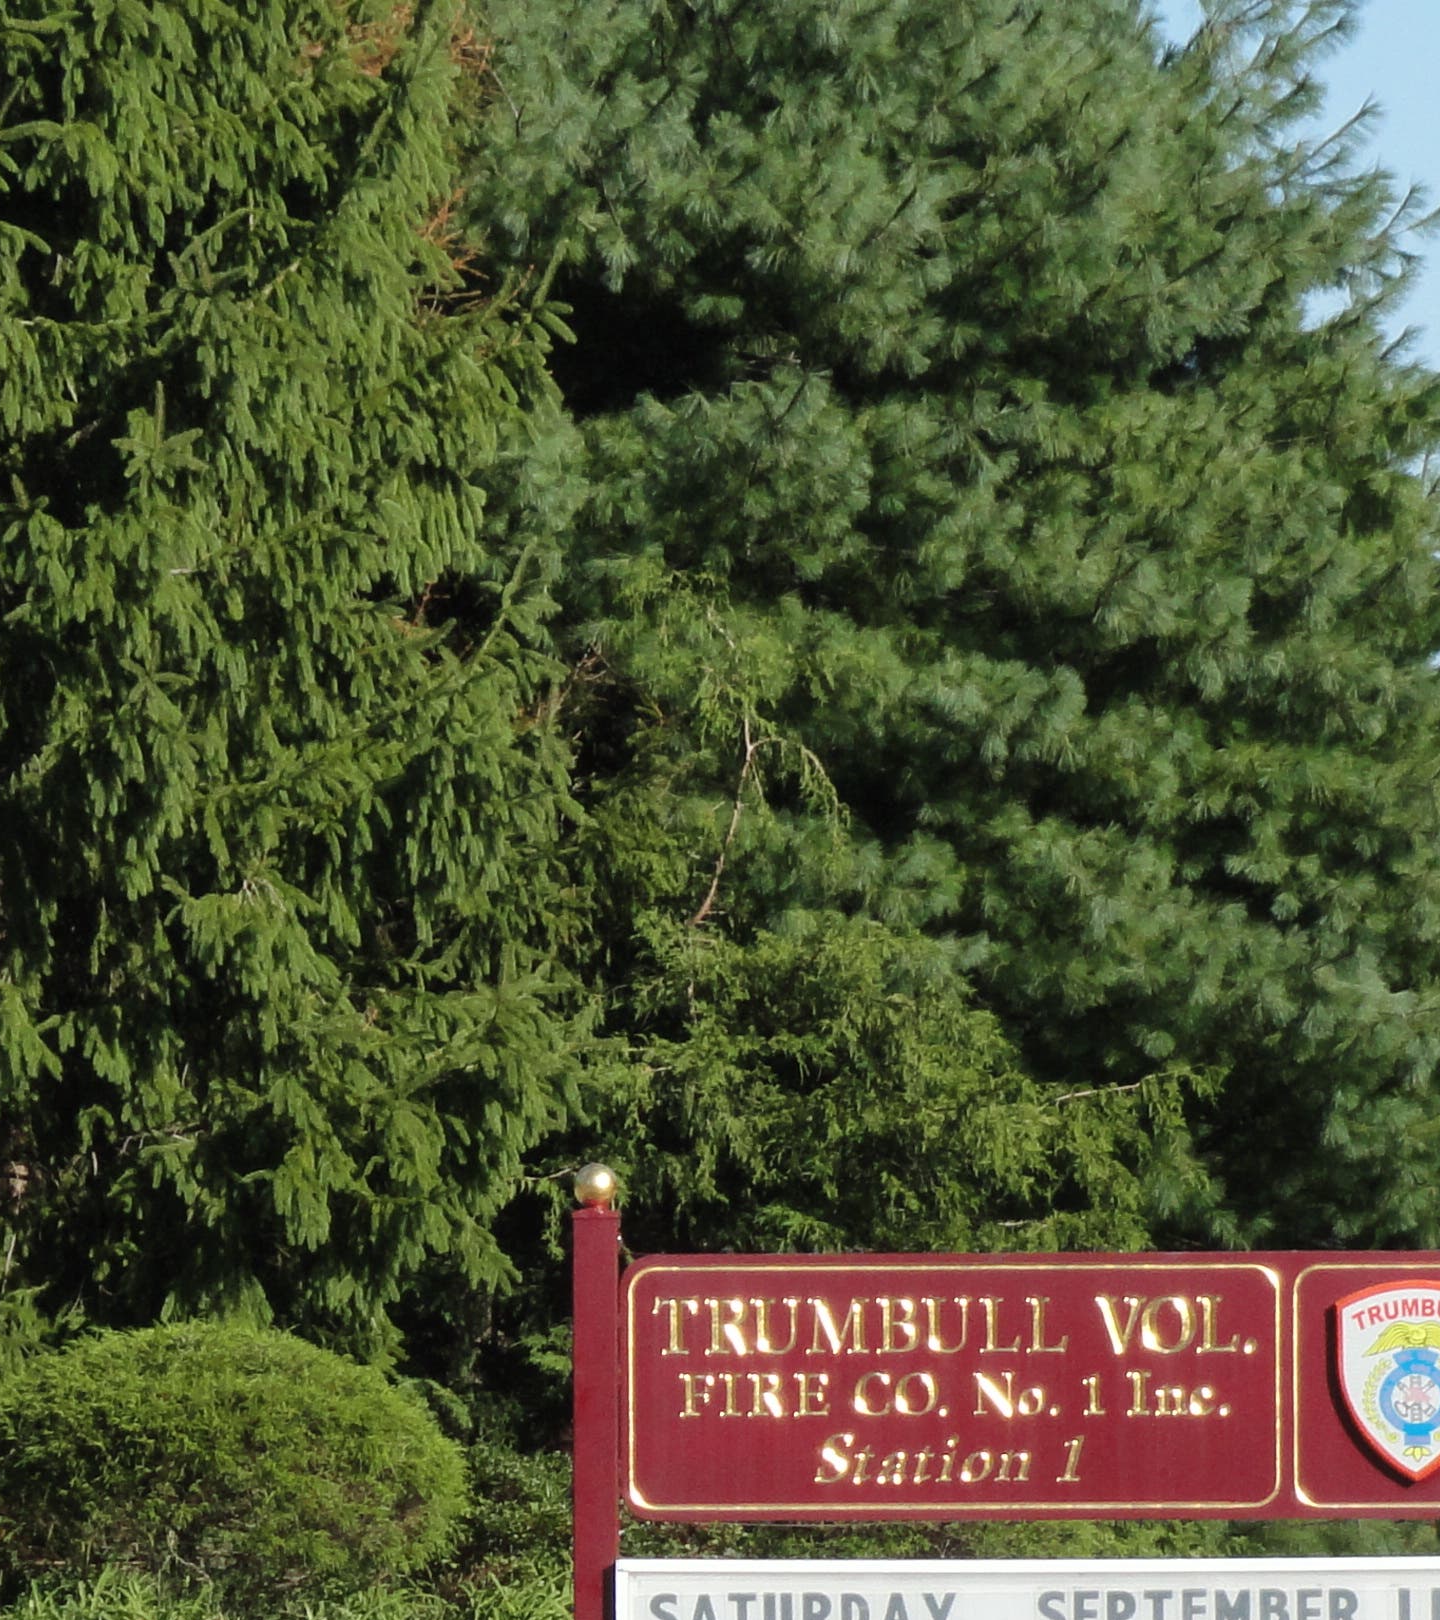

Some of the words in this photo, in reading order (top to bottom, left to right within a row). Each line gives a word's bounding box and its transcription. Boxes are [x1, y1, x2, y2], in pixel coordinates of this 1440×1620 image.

[652, 1296, 1069, 1355] TRUMBULL
[1094, 1295, 1258, 1355] VOL.
[678, 1371, 831, 1418] FIRE
[854, 1370, 949, 1418] CO.
[972, 1370, 1059, 1418] No.
[1082, 1373, 1106, 1416] 1
[1125, 1370, 1232, 1416] Inc.
[813, 1432, 1032, 1485] Station
[1056, 1434, 1085, 1482] 1
